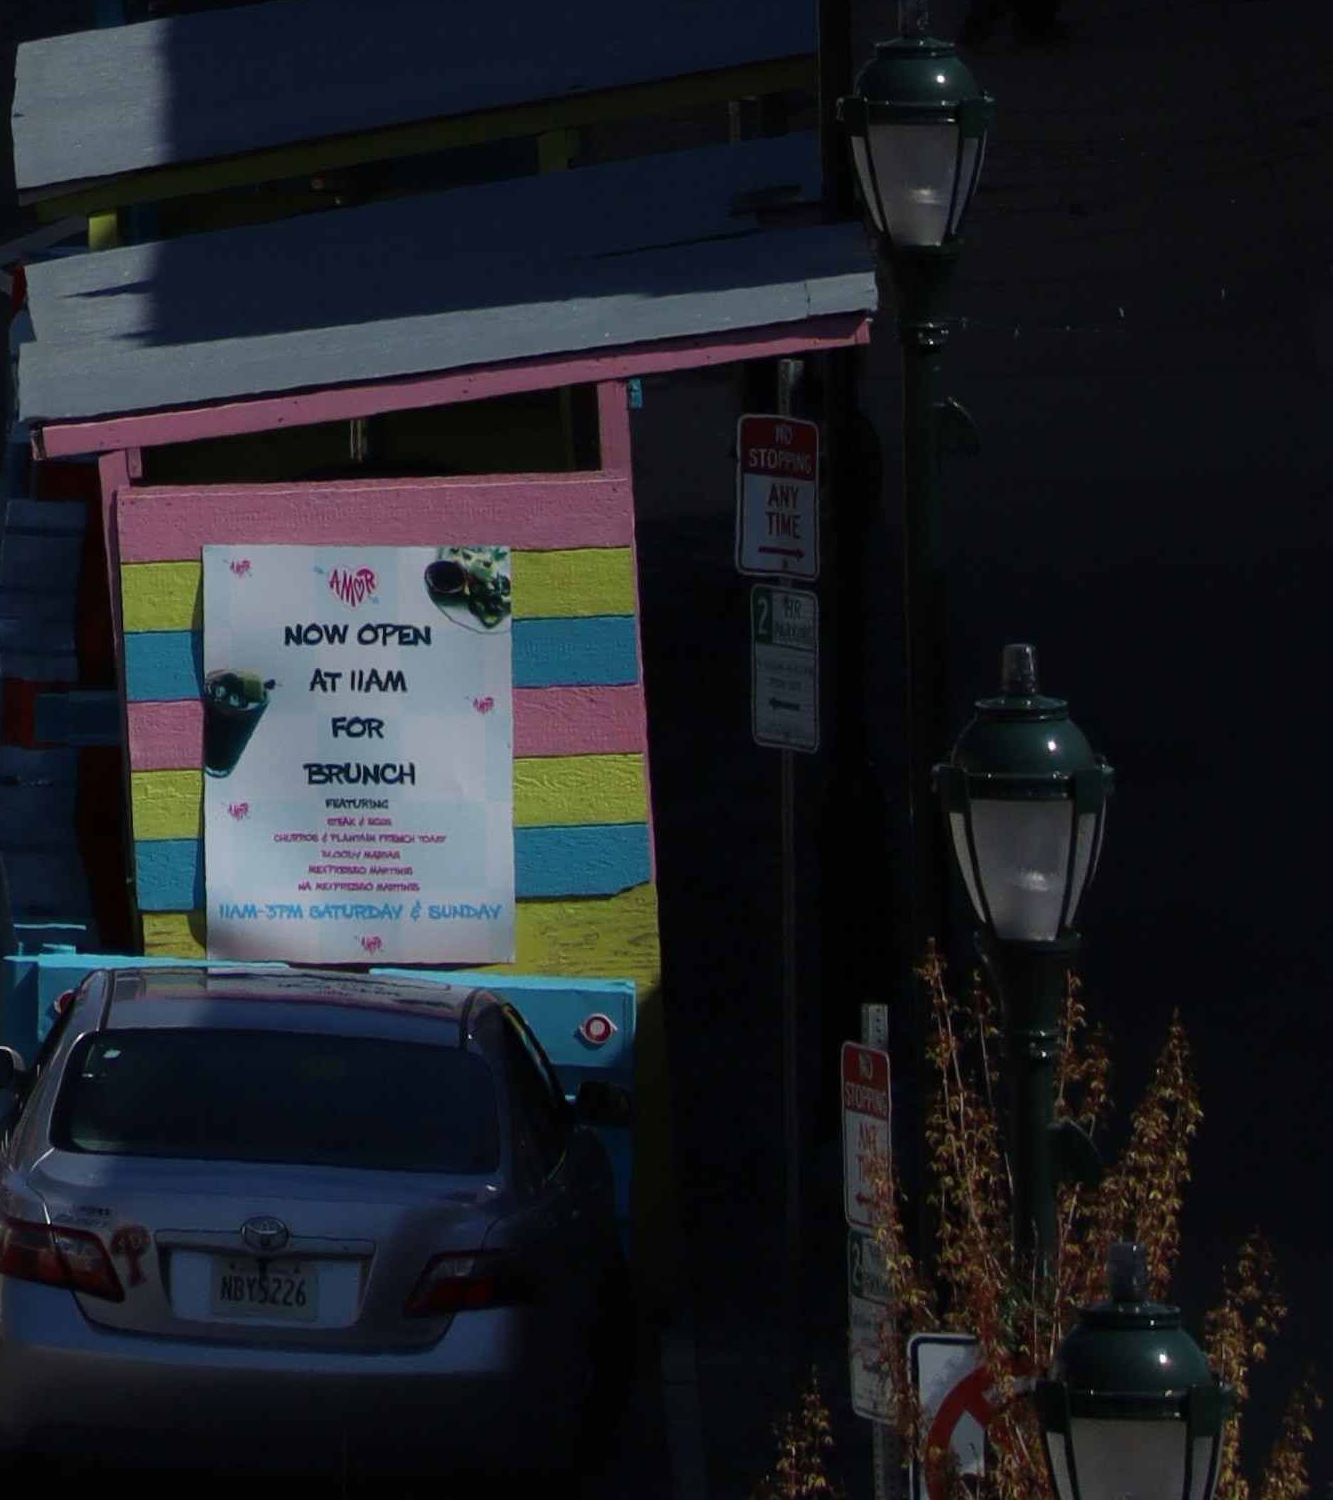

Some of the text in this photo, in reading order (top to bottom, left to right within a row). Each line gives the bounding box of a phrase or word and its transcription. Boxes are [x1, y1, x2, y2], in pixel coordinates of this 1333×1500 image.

[774, 423, 793, 445] NO
[748, 447, 813, 474] STOPPING
[768, 483, 800, 509] ANY
[765, 511, 802, 539] TIME
[757, 596, 802, 635] 2 HR
[284, 622, 431, 647] NOW OPEN
[310, 668, 407, 693] AT 11AM
[331, 716, 385, 739] FOR
[303, 762, 416, 785] BRUNCH
[325, 798, 389, 809] FEATURING
[327, 817, 356, 827] STEAK
[274, 833, 319, 844] CHURROS
[330, 834, 376, 844] PLANTAIN
[378, 834, 416, 844] FRENCH
[418, 834, 448, 843] TOAST
[321, 850, 362, 860] BLOODY
[369, 866, 414, 876] MARTINIS
[375, 882, 421, 892] MARTINIS
[219, 900, 502, 921] 11AM-3PM SATURDAY & SUNDAY
[858, 1050, 874, 1081] NO
[844, 1081, 887, 1116] STOPPING
[852, 1242, 861, 1286] 2
[219, 1275, 307, 1307] NBY5226
